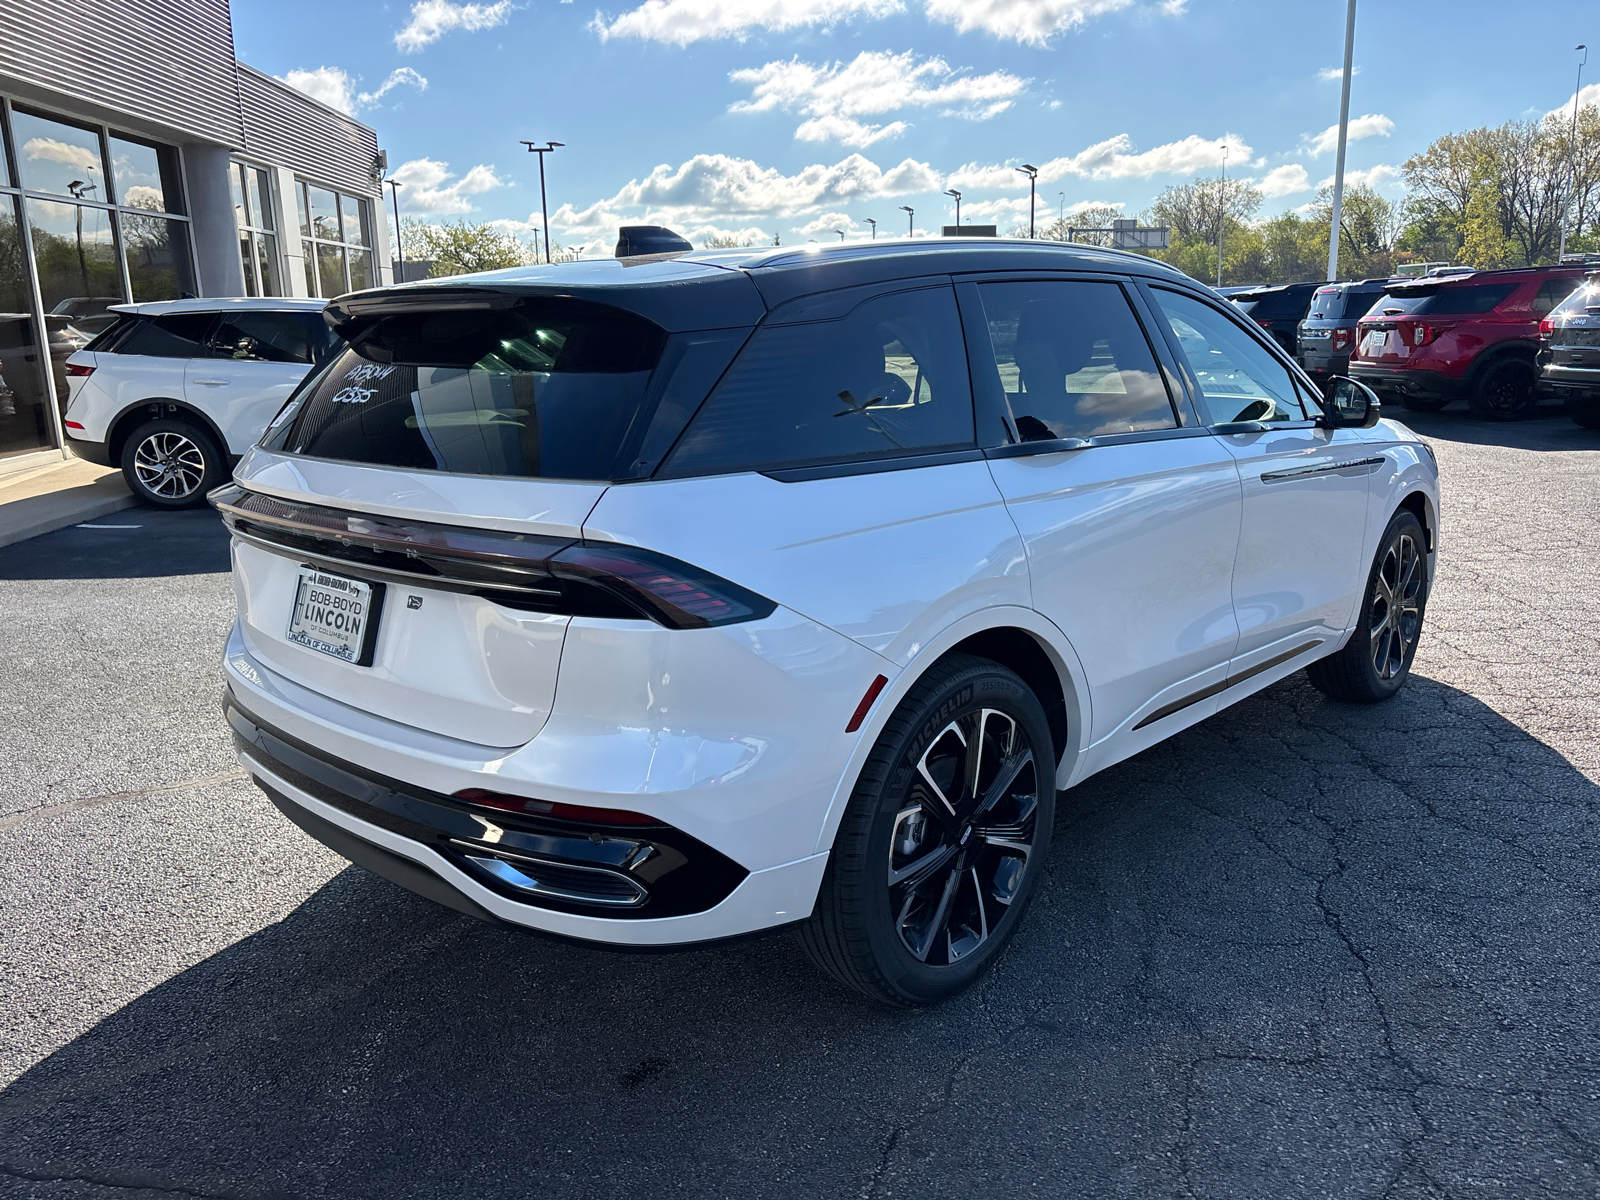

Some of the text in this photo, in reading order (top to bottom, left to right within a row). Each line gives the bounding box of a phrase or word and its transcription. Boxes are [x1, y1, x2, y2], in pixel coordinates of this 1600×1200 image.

[309, 589, 362, 615] BOB-BOYD
[304, 603, 361, 636] LINCOLN
[288, 632, 354, 661] LINCOLN OF COLUMBUS
[318, 627, 349, 642] COLUMBUS
[907, 686, 972, 765] MICHELIN
